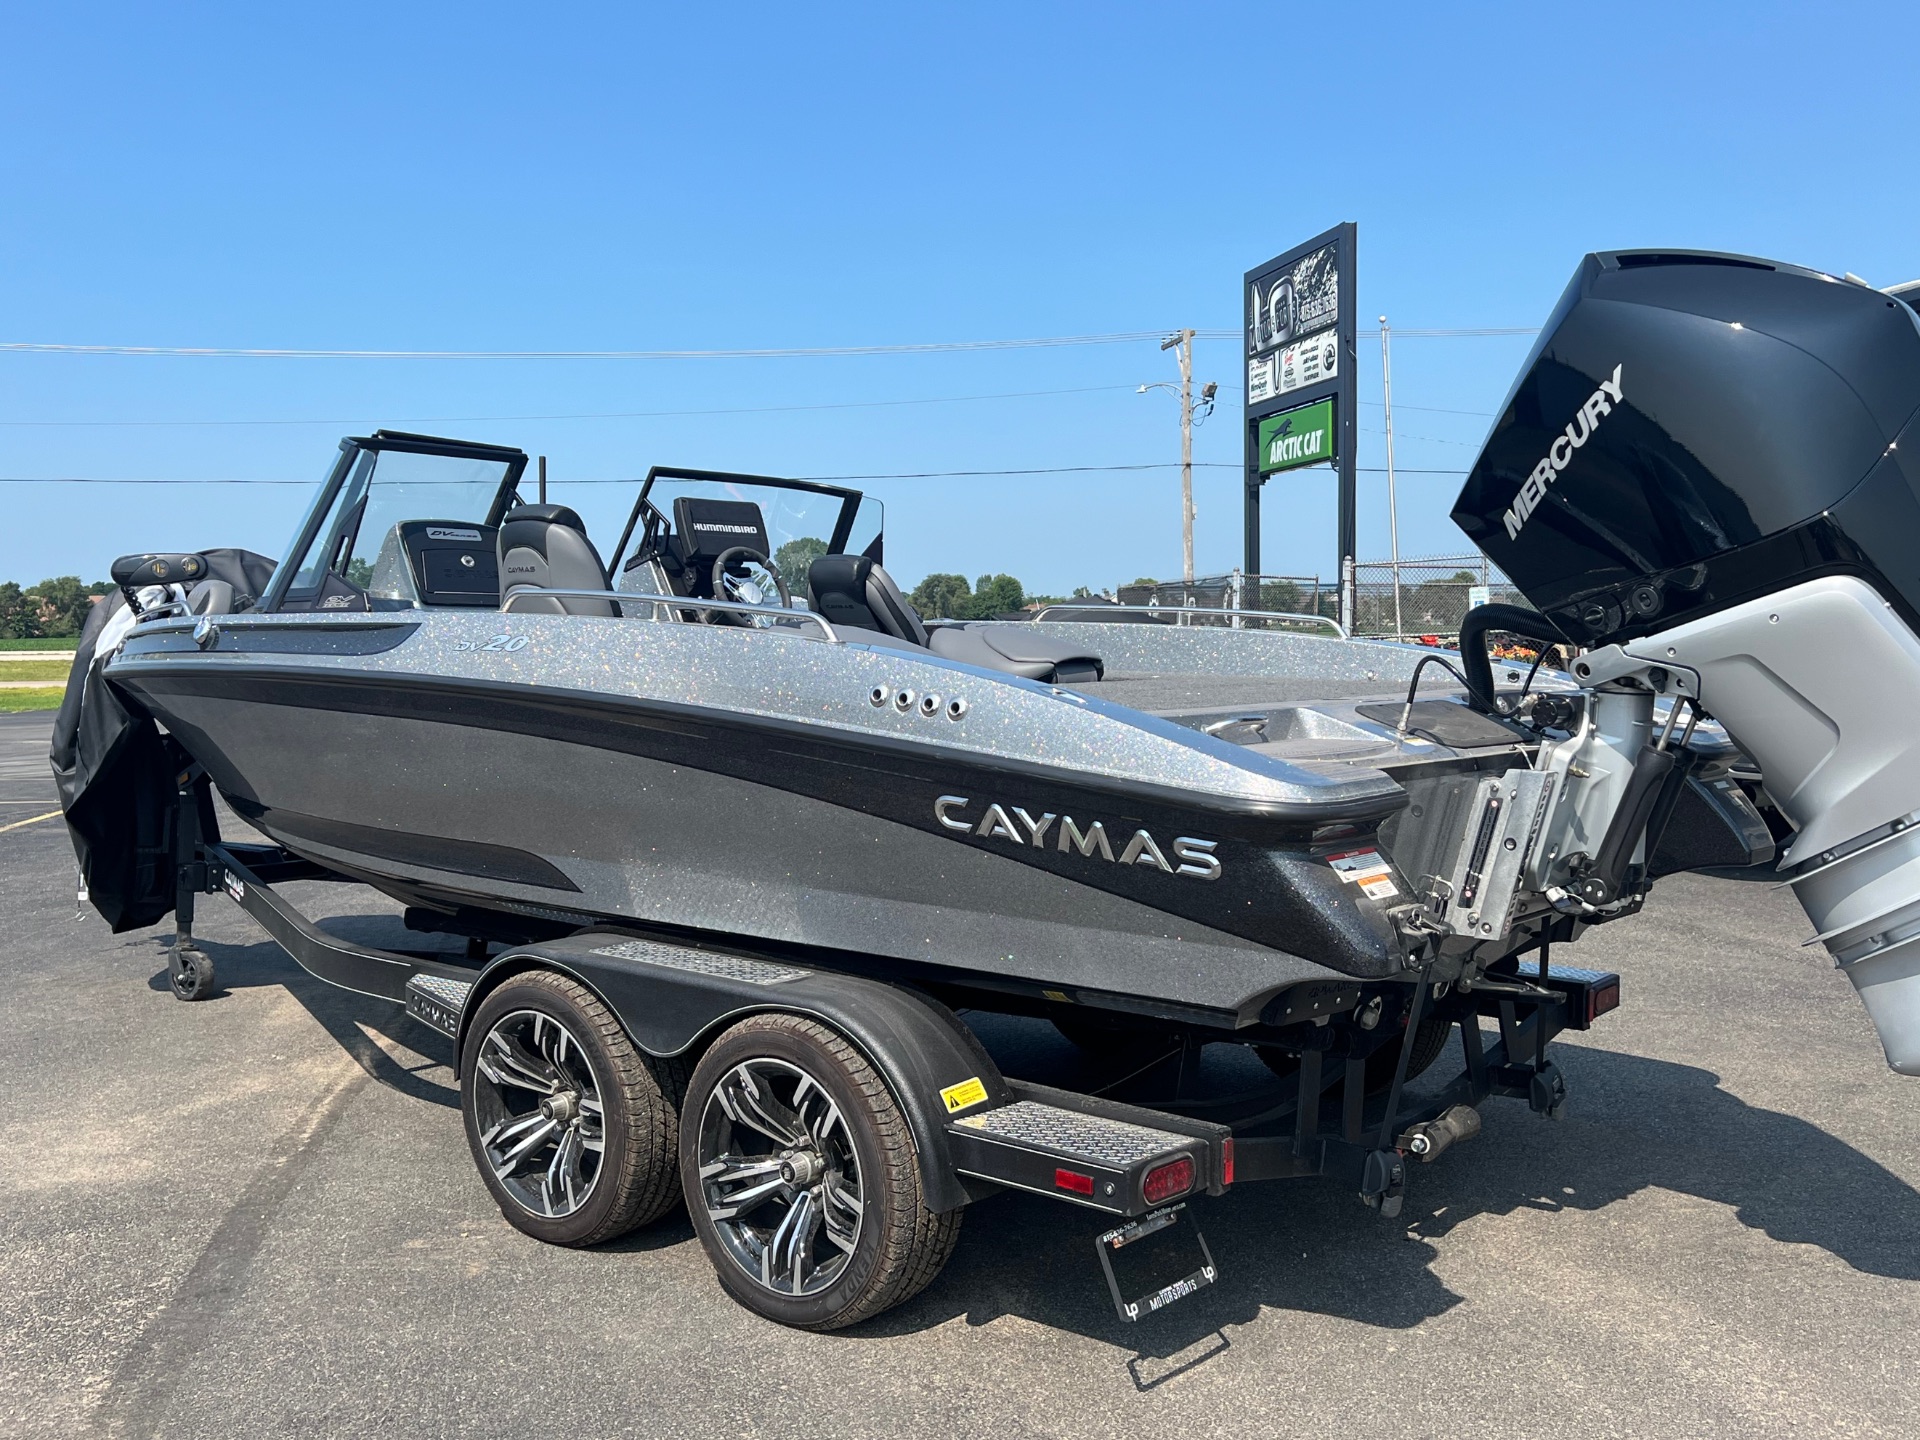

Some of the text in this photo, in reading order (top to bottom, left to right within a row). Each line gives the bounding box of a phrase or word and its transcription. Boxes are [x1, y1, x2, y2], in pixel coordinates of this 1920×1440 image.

[1269, 429, 1322, 465] ARCTIC CAT
[1502, 362, 1624, 541] MERCURY
[693, 522, 758, 535] HUMMINBIRD
[507, 565, 536, 574] CAYMAS
[934, 794, 1223, 881] CAYMAS
[411, 994, 457, 1032] CAYMAS
[838, 1240, 876, 1302] KENDA
[1149, 1279, 1197, 1311] MOTORSPORTS
